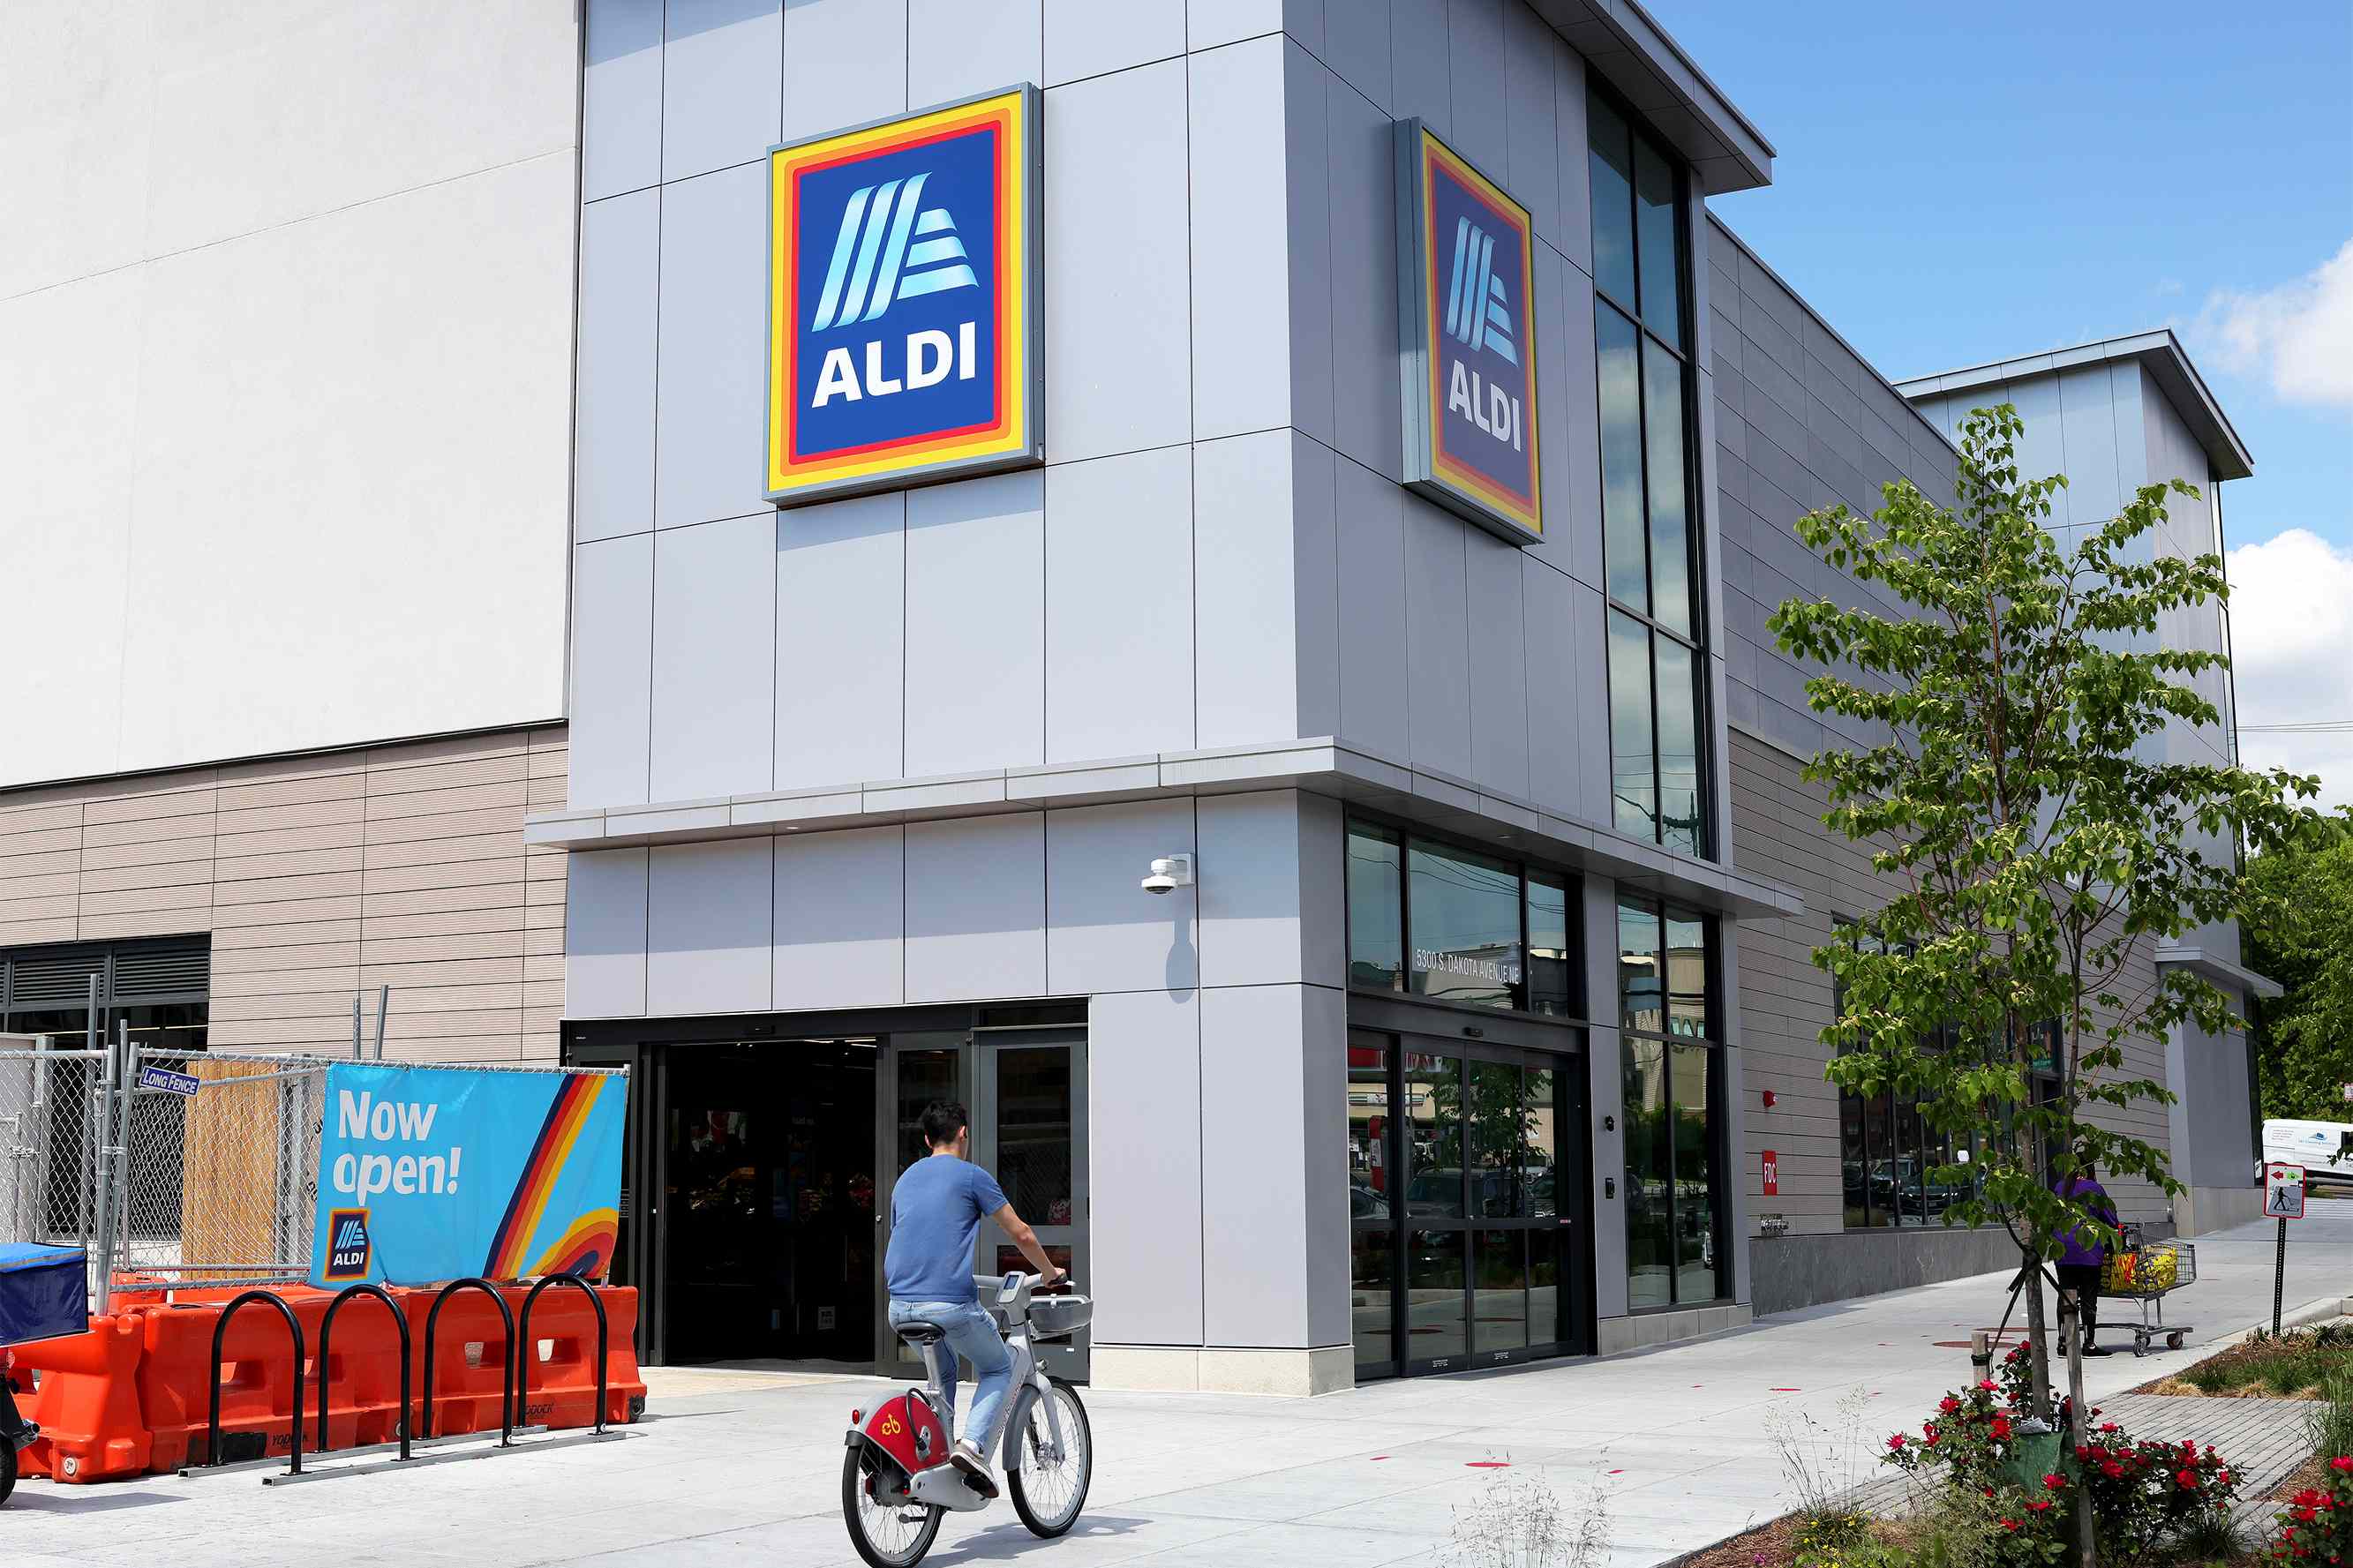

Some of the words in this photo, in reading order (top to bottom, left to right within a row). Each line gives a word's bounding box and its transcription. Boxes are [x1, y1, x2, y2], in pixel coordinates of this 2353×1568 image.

[811, 321, 976, 408] ALDI
[1448, 359, 1521, 452] ALDI
[1417, 949, 1437, 969] 5300
[1447, 955, 1477, 977] DAKOTA
[1478, 961, 1507, 982] AVENUE
[1509, 967, 1518, 984] NE
[142, 1069, 168, 1087] LONG
[168, 1074, 197, 1094] FENCE
[338, 1089, 438, 1141] Now
[333, 1147, 462, 1206] open!
[1764, 1162, 1777, 1183] FDC
[333, 1252, 365, 1266] ALDI
